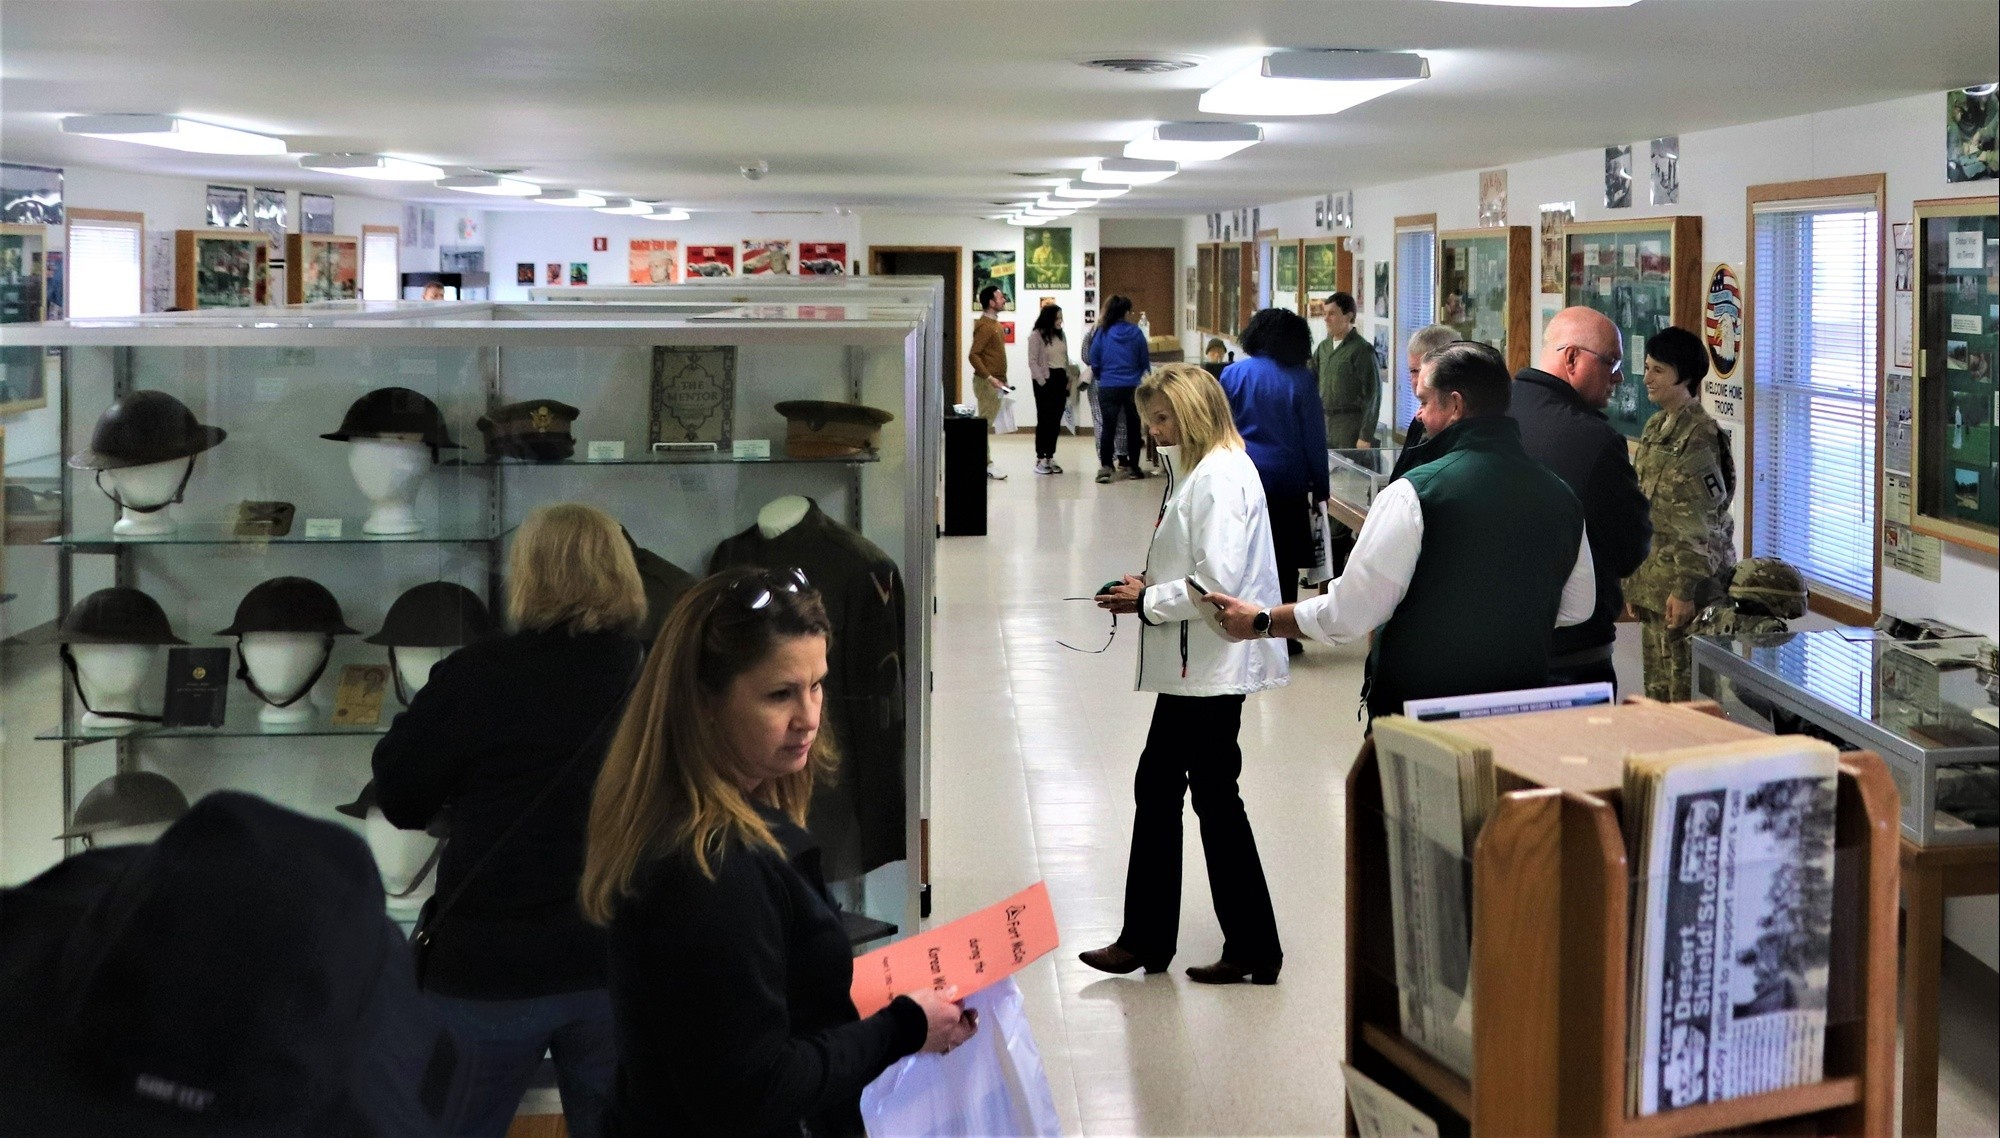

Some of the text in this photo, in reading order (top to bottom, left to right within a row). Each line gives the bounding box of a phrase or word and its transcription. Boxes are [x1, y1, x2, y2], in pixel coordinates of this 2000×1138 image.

[668, 391, 719, 402] MENTOR
[681, 381, 704, 390] THE
[1705, 381, 1743, 400] WELCOME HOME
[1714, 400, 1734, 416] TROOPS
[1730, 789, 1741, 819] call
[1726, 824, 1738, 891] nation's
[1007, 920, 1026, 966] Fort McCoy
[1693, 834, 1720, 1018] Shield/Storm
[1722, 898, 1734, 961] support
[928, 946, 942, 974] Korean
[969, 938, 985, 974] during the
[1673, 924, 1697, 1021] Desert
[1719, 968, 1731, 986] to
[1664, 978, 1674, 1014] Back
[1661, 1016, 1673, 1051] Look
[1716, 991, 1729, 1041] rallied
